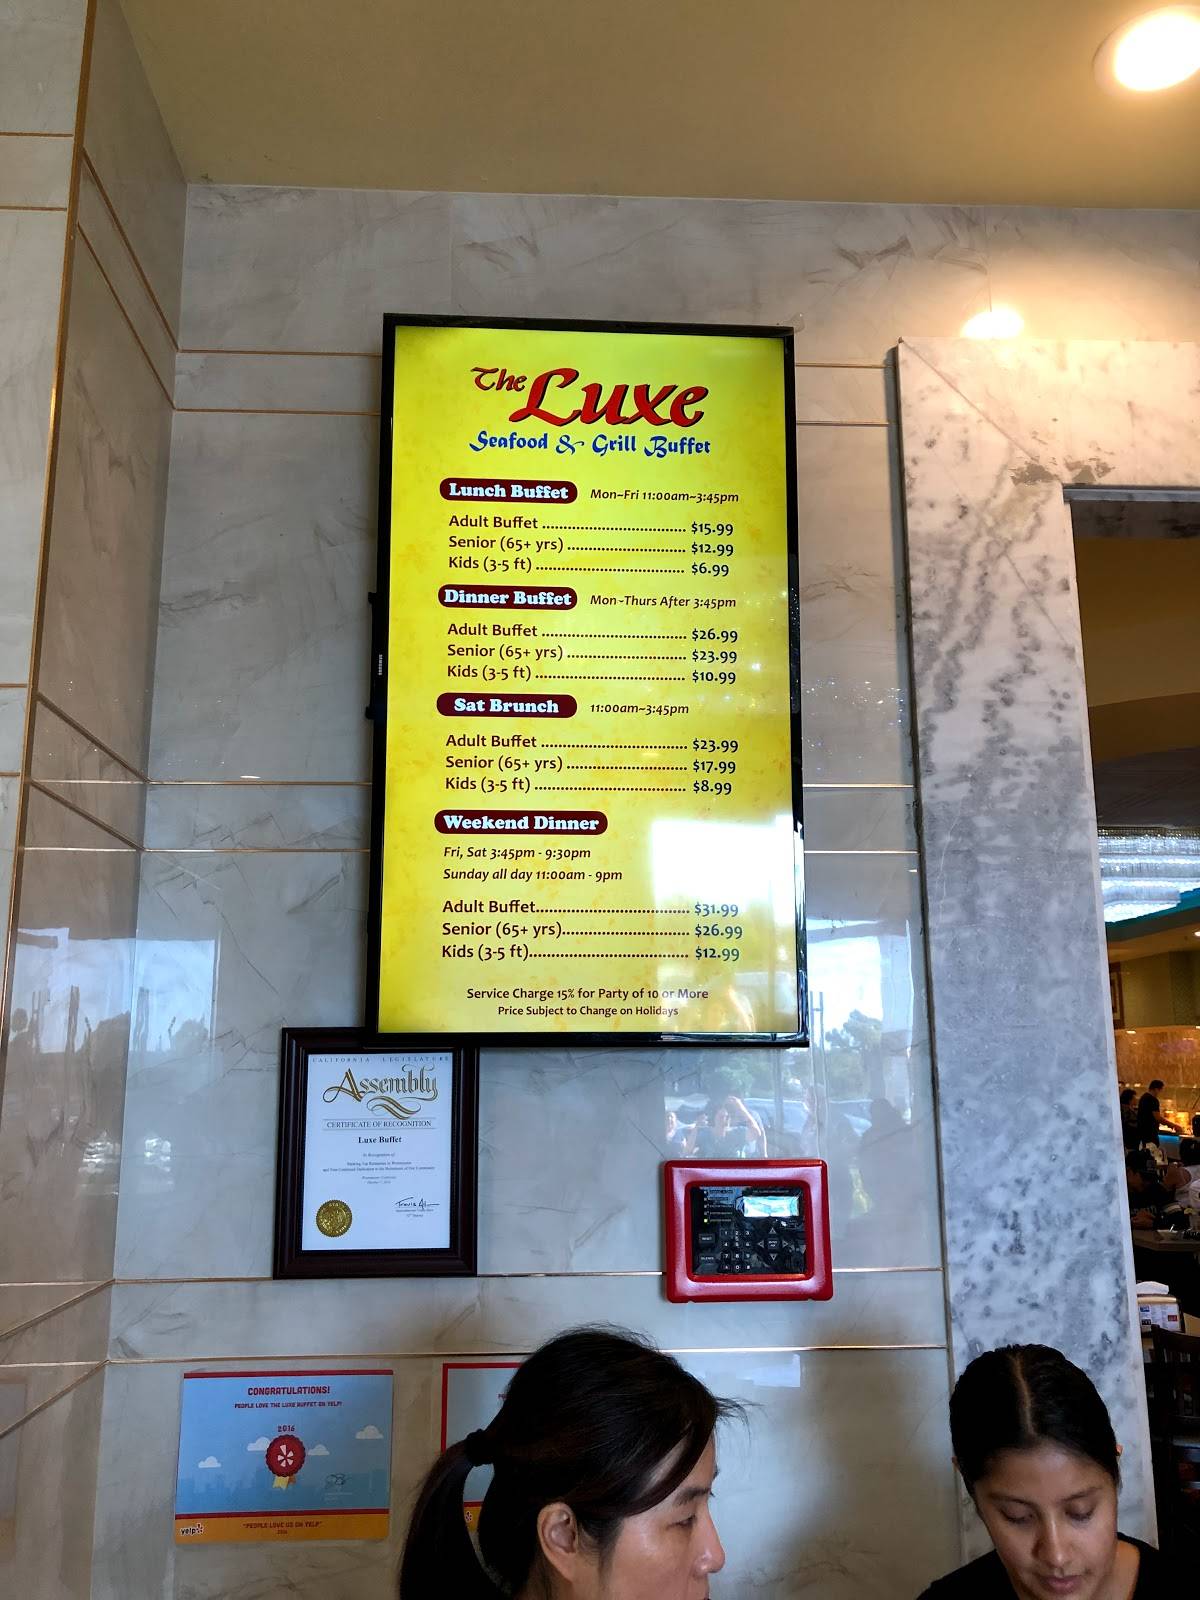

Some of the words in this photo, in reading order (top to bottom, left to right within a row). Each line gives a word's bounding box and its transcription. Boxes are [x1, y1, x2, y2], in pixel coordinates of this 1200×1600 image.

[470, 367, 527, 392] The
[508, 367, 709, 428] Luxe
[469, 430, 548, 451] Seafood
[555, 435, 585, 456] &
[591, 434, 636, 456] Grill
[644, 435, 711, 457] Buffet
[449, 483, 506, 498] Lunch
[511, 484, 569, 499] Buffet
[449, 515, 489, 528] Adult
[493, 516, 538, 529] Buffet
[691, 521, 734, 536] $15.99
[449, 536, 496, 548] Senior
[500, 536, 531, 552] (65+
[536, 537, 563, 553] yrs)
[691, 541, 734, 556] $12.99
[449, 556, 479, 569] Kids
[483, 556, 509, 573] (3-5
[514, 557, 532, 573] ft)
[691, 562, 729, 577] $6.99
[444, 589, 509, 604] Dinner
[513, 591, 571, 605] Buffet
[660, 596, 690, 608] After
[693, 598, 736, 610] 3:45pm
[447, 623, 488, 635] Adult
[492, 624, 538, 637] Buffet
[692, 628, 738, 643] $26.99
[447, 644, 495, 657] Senior
[499, 644, 530, 661] (65+
[535, 645, 563, 661] yrs)
[692, 649, 737, 664] $23.99
[447, 665, 478, 677] Kids
[482, 665, 509, 681] (3-5
[513, 665, 531, 682] ft)
[692, 670, 736, 685] $10.99
[454, 697, 485, 712] Sat
[490, 698, 559, 713] Brunch
[446, 734, 487, 747] Adult
[491, 735, 537, 748] Buffet
[692, 738, 738, 753] $23.99
[445, 755, 494, 768] Senior
[498, 755, 529, 772] (65+
[535, 756, 563, 772] yrs)
[693, 759, 736, 774] $17.99
[445, 777, 477, 790] Kids
[481, 776, 507, 793] (3-5
[512, 777, 530, 793] ft)
[693, 780, 732, 795] $8.99
[443, 815, 529, 830] Weekend
[533, 816, 599, 830] Dinner
[444, 847, 463, 859] Fri,
[467, 847, 487, 858] Sat
[490, 848, 535, 860] 3:45pm
[545, 849, 591, 860] 9:30pm
[443, 868, 489, 882] Sunday
[492, 868, 507, 880] all
[510, 869, 532, 882] day
[536, 870, 585, 880] 11:00am
[595, 871, 622, 882] 9pm
[442, 899, 484, 913] Adult
[489, 900, 535, 913] Buffet
[694, 901, 739, 917] $31.99
[442, 922, 491, 936] Senior
[496, 921, 528, 939] (65+
[695, 924, 743, 939] $26.99
[442, 944, 474, 958] Kids
[478, 944, 505, 961] (3-5
[695, 946, 740, 961] $12.99
[467, 988, 509, 999] Service
[513, 988, 554, 1001] Charge
[557, 988, 575, 1000] 15%
[578, 988, 595, 999] for
[599, 988, 629, 1001] Party
[632, 988, 644, 999] of
[648, 990, 659, 999] 10
[661, 990, 674, 999] or
[677, 988, 709, 999] More
[498, 1006, 524, 1015] Price
[526, 1006, 564, 1017] Subject
[566, 1007, 577, 1015] to
[580, 1006, 617, 1018] Change
[620, 1007, 633, 1015] on
[635, 1006, 679, 1018] Holidays
[323, 1064, 438, 1105] Assembly
[383, 1120, 432, 1128] RECOGNITION
[358, 1136, 377, 1144] Luxe
[379, 1136, 402, 1144] Buffet
[247, 1385, 331, 1396] CONGRATULATIONS!
[277, 1425, 295, 1433] 2016
[180, 1526, 197, 1537] yelp
